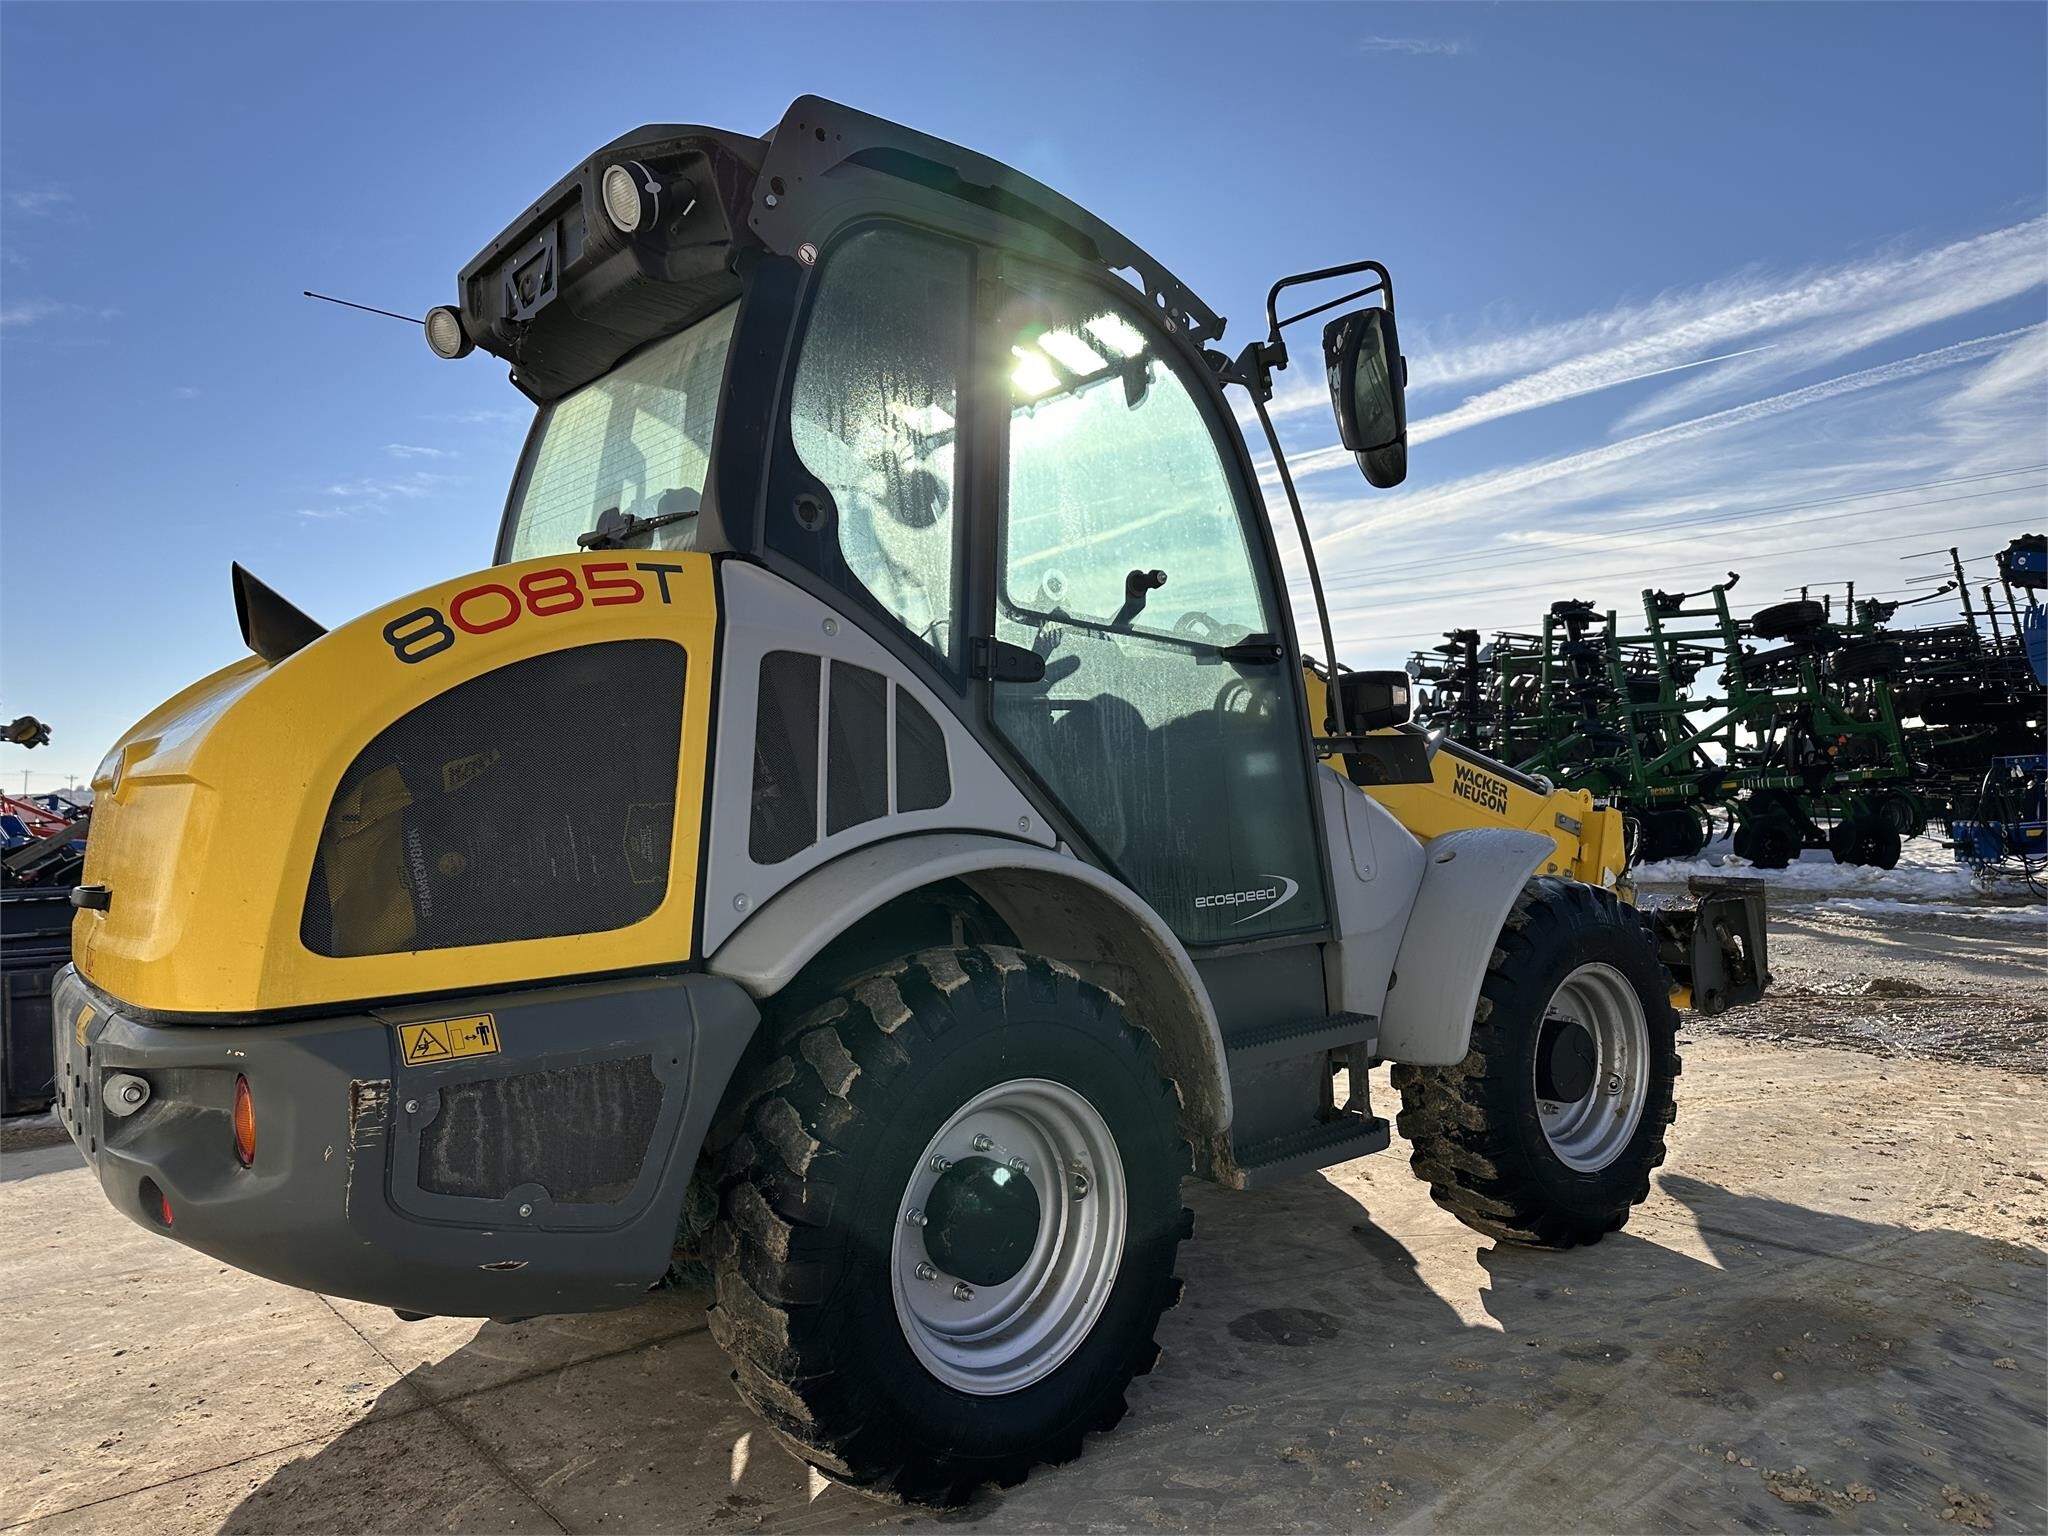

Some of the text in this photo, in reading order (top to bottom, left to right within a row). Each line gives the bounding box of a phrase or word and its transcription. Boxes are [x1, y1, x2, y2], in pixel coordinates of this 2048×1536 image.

[383, 562, 684, 664] 8085T
[1453, 779, 1507, 815] NEUSON
[1455, 763, 1508, 800] WACKER
[1195, 886, 1277, 908] ecospeed
